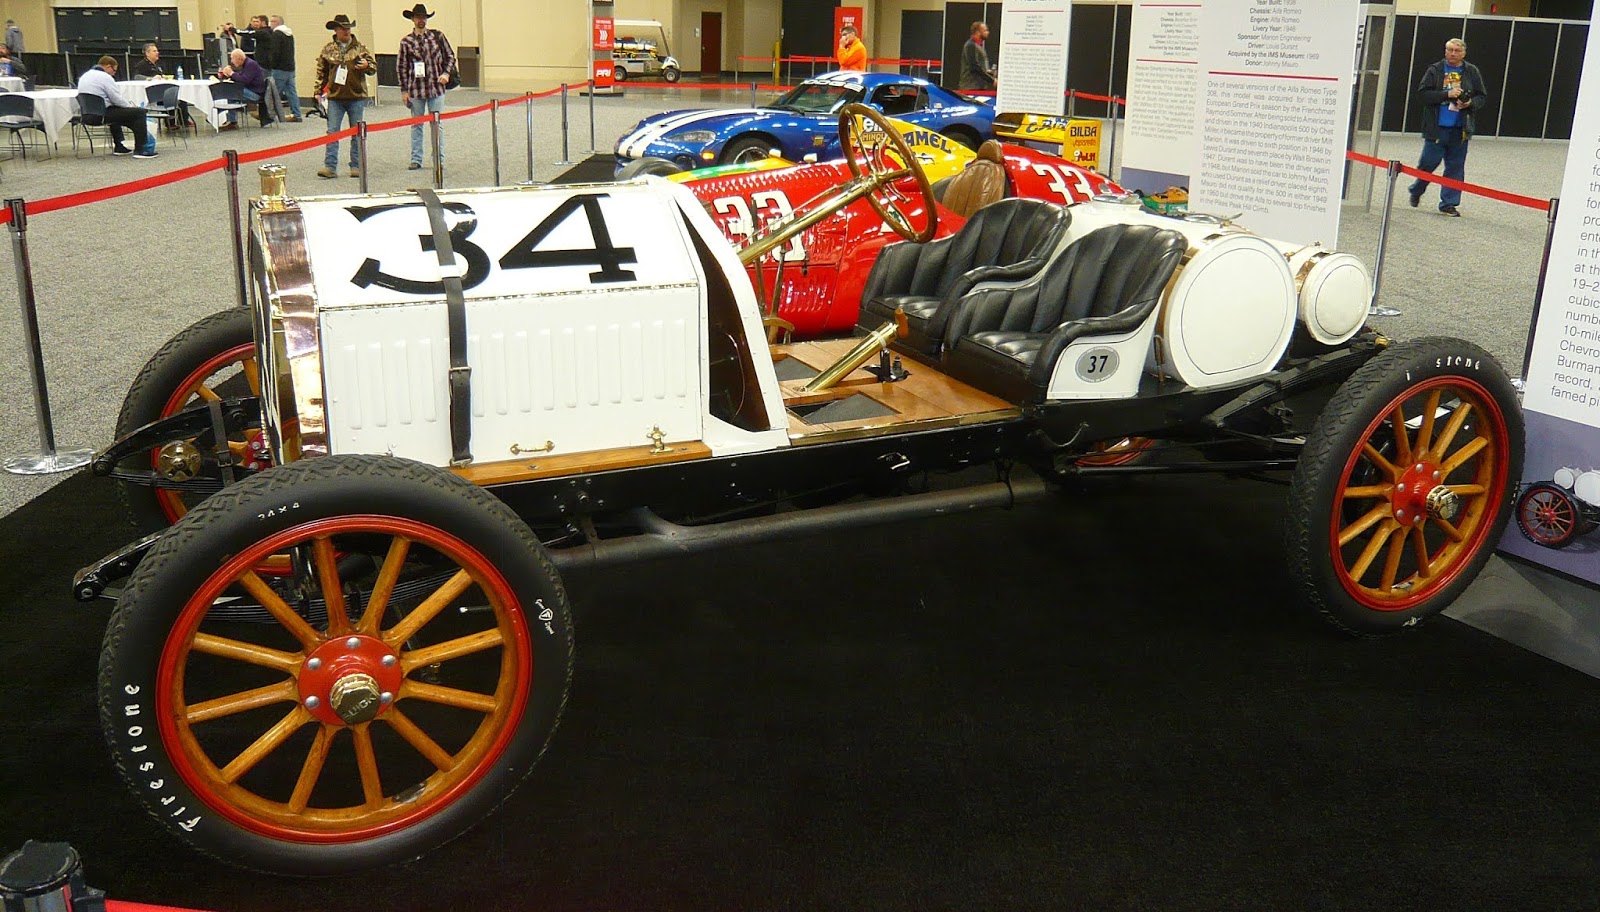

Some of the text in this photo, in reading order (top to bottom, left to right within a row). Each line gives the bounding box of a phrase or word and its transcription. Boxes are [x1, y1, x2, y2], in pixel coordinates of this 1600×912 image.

[1280, 35, 1311, 43] Engineering
[1228, 50, 1250, 58] Acquired
[1070, 127, 1097, 137] BILBA
[892, 131, 952, 154] AMEL
[345, 193, 638, 294] 34
[1577, 244, 1588, 258] in
[1574, 263, 1586, 274] at
[1568, 295, 1600, 309] cubic
[1565, 310, 1600, 325] numb
[1559, 339, 1600, 358] Chevro
[1088, 355, 1108, 373] 37
[1554, 372, 1593, 390] record,
[1551, 385, 1587, 404] famed
[125, 684, 201, 832] Firestone
